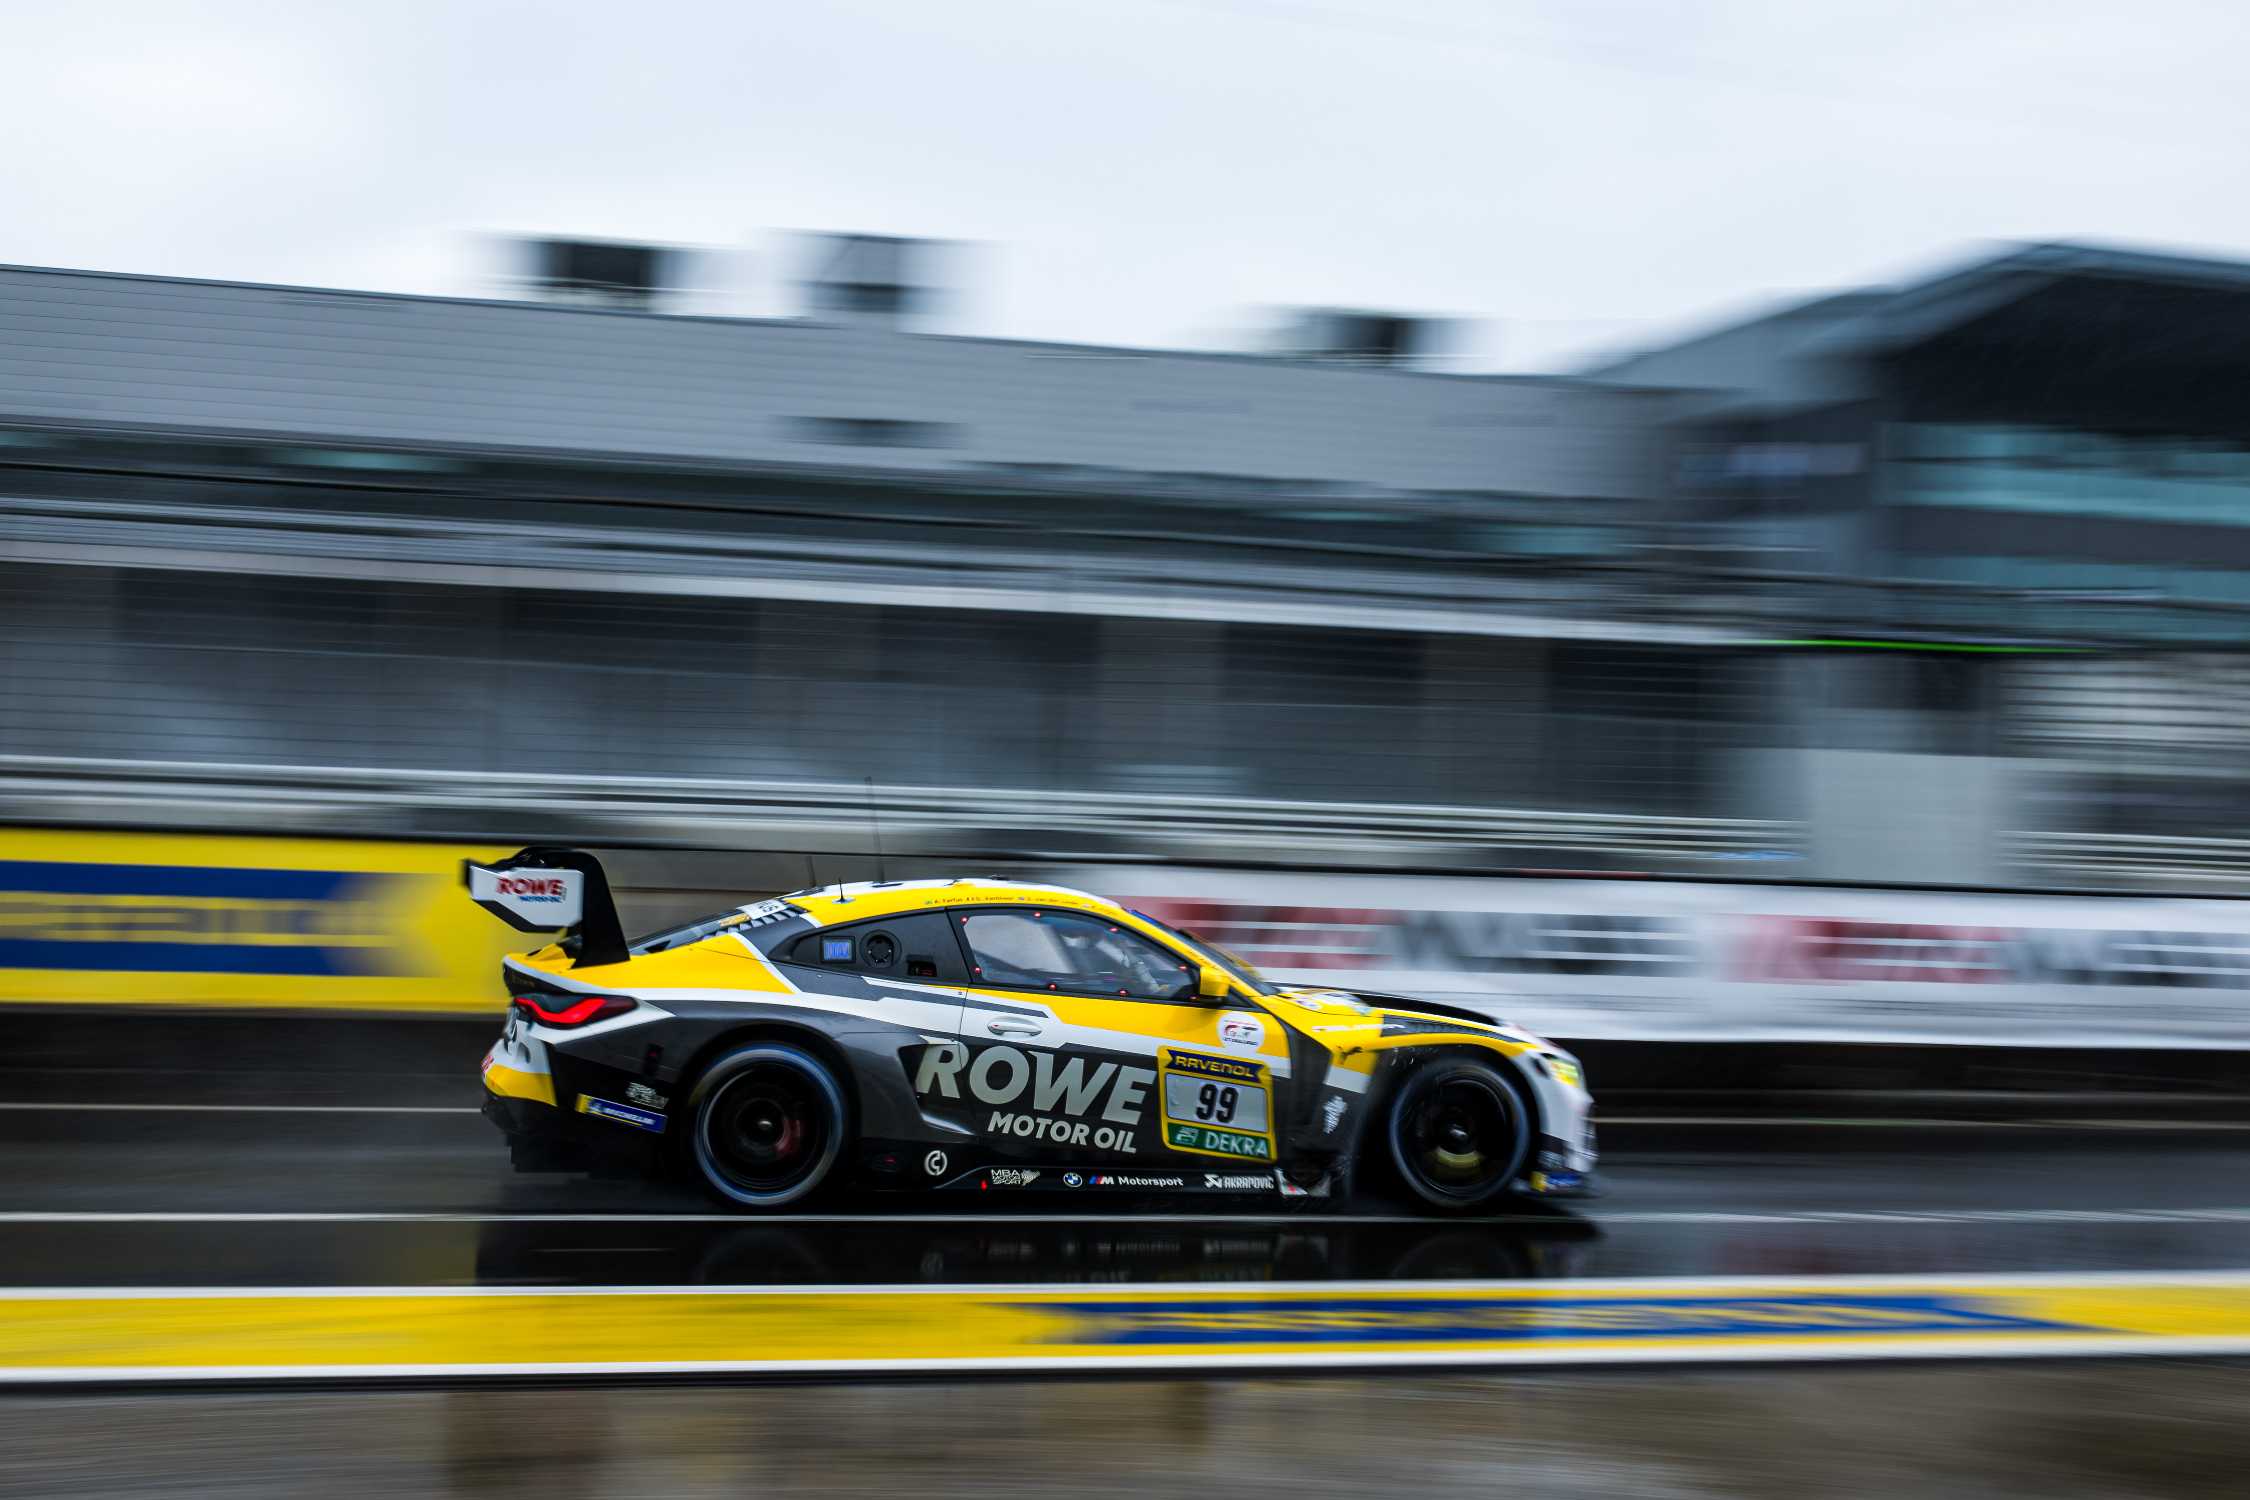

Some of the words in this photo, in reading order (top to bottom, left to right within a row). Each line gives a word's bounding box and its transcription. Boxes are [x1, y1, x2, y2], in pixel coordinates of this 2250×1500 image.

[496, 878, 564, 896] ROWE
[915, 1034, 1158, 1126] ROWE
[1175, 1055, 1255, 1078] RAVENOL
[1195, 1083, 1239, 1123] 99
[987, 1111, 1091, 1146] MOTOR
[1094, 1126, 1137, 1154] OIL
[1205, 1131, 1270, 1158] DEKRA
[1118, 1176, 1184, 1187] Motorsport
